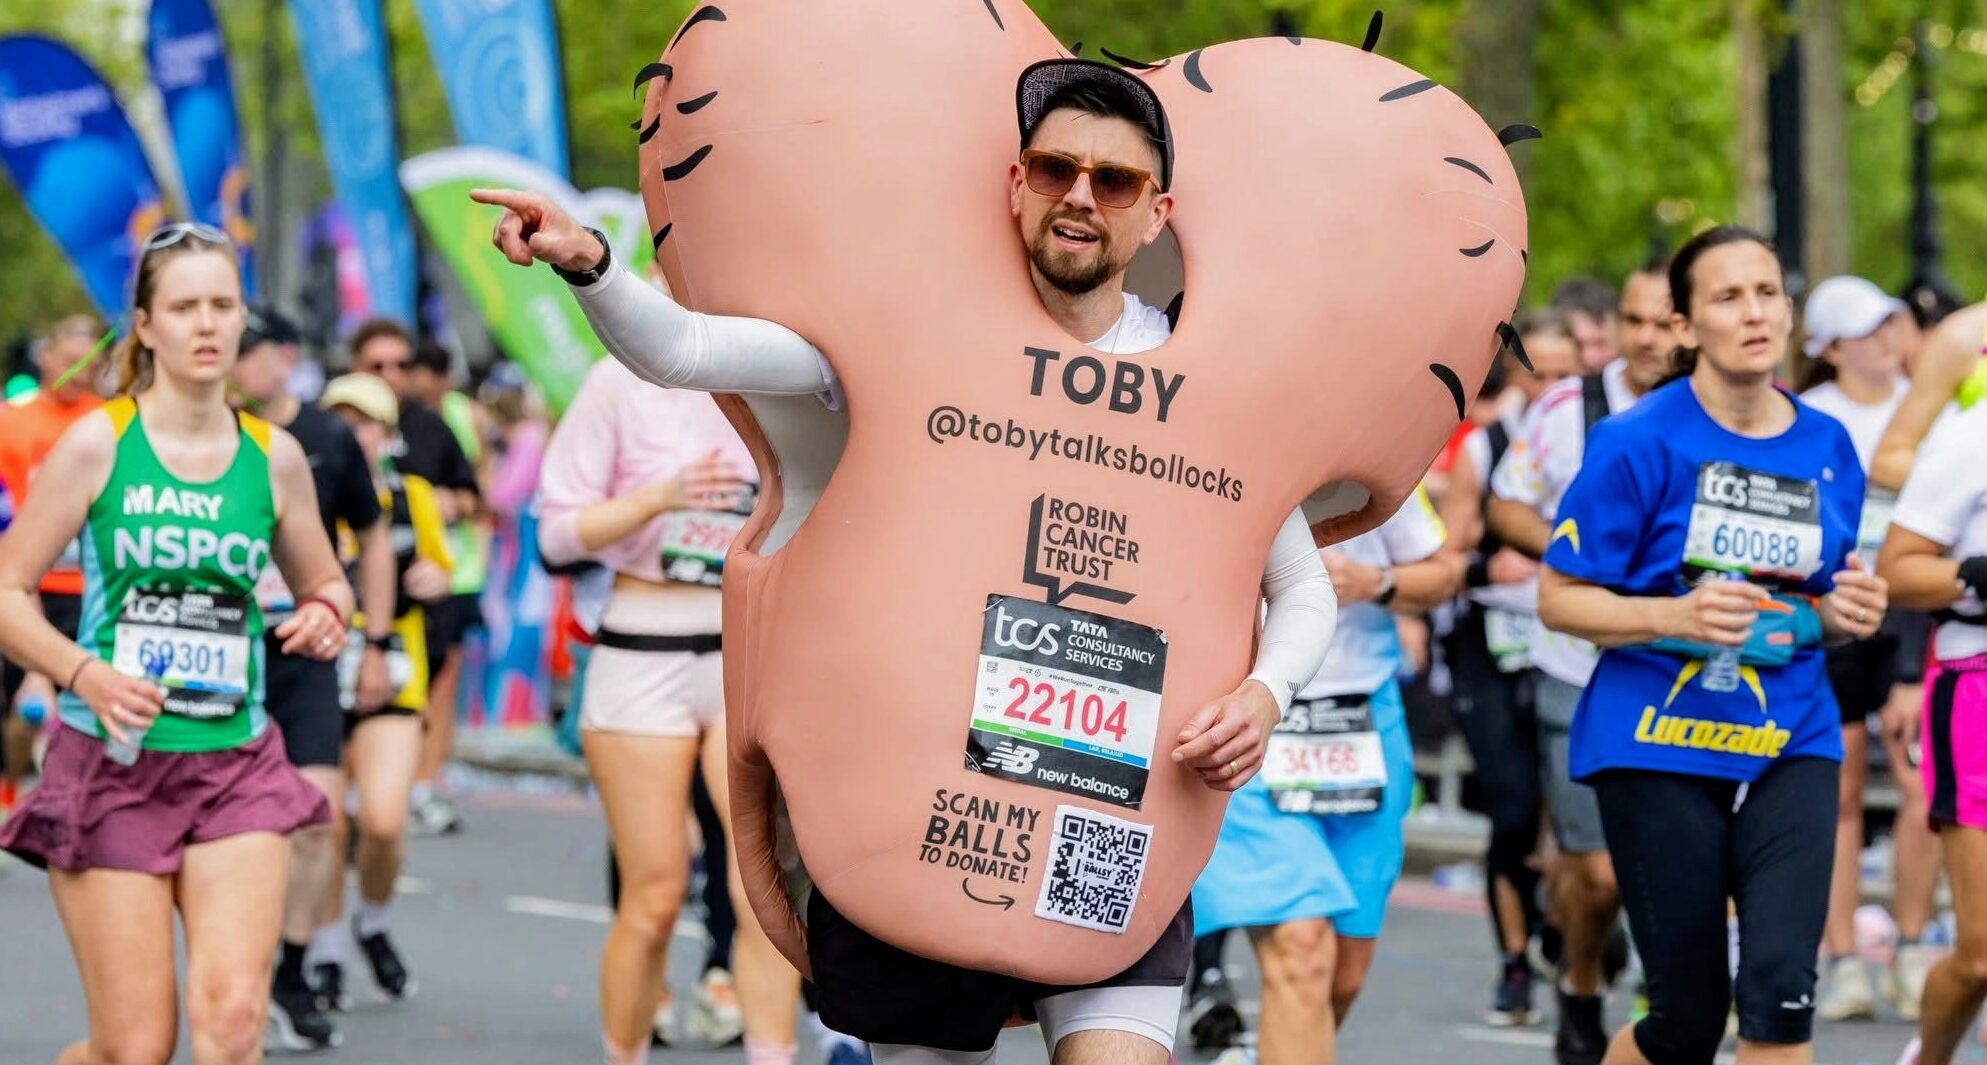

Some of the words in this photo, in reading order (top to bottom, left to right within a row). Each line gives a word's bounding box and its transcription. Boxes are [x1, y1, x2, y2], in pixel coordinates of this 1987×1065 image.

[1023, 346, 1186, 423] TOBY
[927, 405, 1243, 502] @tobytalksbollocks
[123, 484, 223, 521] MARY
[1703, 464, 1748, 507] tcs
[1048, 498, 1128, 536] ROBIN
[1043, 546, 1114, 582] TRUST
[1045, 523, 1140, 564] CANCER
[1713, 522, 1800, 568] 60088
[994, 605, 1061, 656] tcs
[1067, 634, 1156, 665] CONSULTANCY
[1070, 619, 1108, 639] TATA
[1065, 648, 1123, 672] SERVICES
[1003, 676, 1128, 743] 22104
[1634, 705, 1792, 759] Lucozade
[1037, 766, 1066, 785] new
[1071, 772, 1130, 800] balance
[933, 788, 1000, 824] SCAN
[1006, 804, 1041, 832] MY
[925, 815, 1032, 863] BALLS
[919, 844, 942, 865] TO
[946, 851, 1028, 884] DONATE!
[1084, 863, 1113, 878] BALLSY
